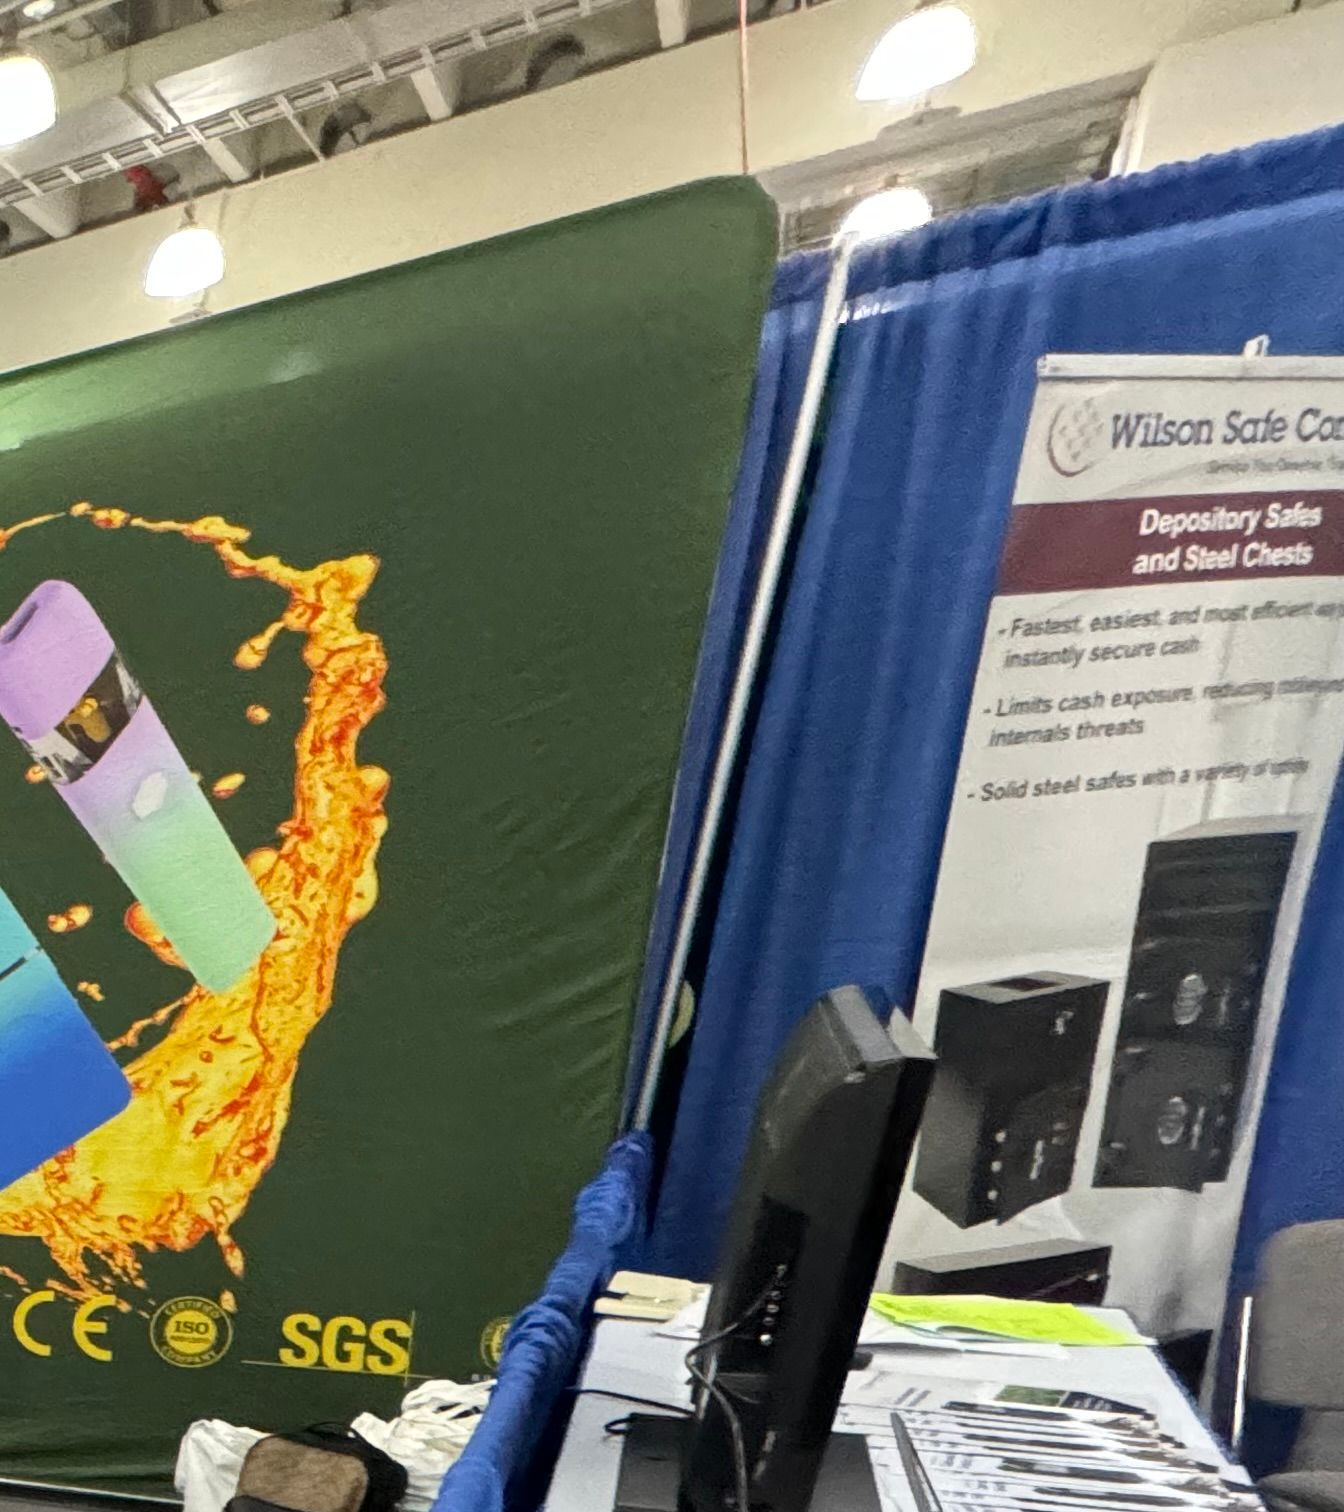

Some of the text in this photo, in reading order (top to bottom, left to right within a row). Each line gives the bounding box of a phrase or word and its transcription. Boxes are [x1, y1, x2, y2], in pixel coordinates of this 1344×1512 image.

[1111, 411, 1214, 450] Wilson
[1223, 408, 1289, 446] Safe
[1138, 501, 1323, 540] Depository Safes
[1132, 540, 1315, 576] and Steel Chests
[1169, 606, 1201, 626] and
[1003, 637, 1200, 670] instantly secure cash
[996, 697, 1053, 718] Limits
[1058, 690, 1106, 713] cash
[987, 717, 1146, 747] internals threats
[981, 779, 1028, 802] Solid
[1032, 774, 1081, 798] steel
[1085, 769, 1137, 792] safes
[12, 1290, 116, 1361] CE
[174, 1320, 211, 1335] ISO
[278, 1312, 413, 1374] SGS
